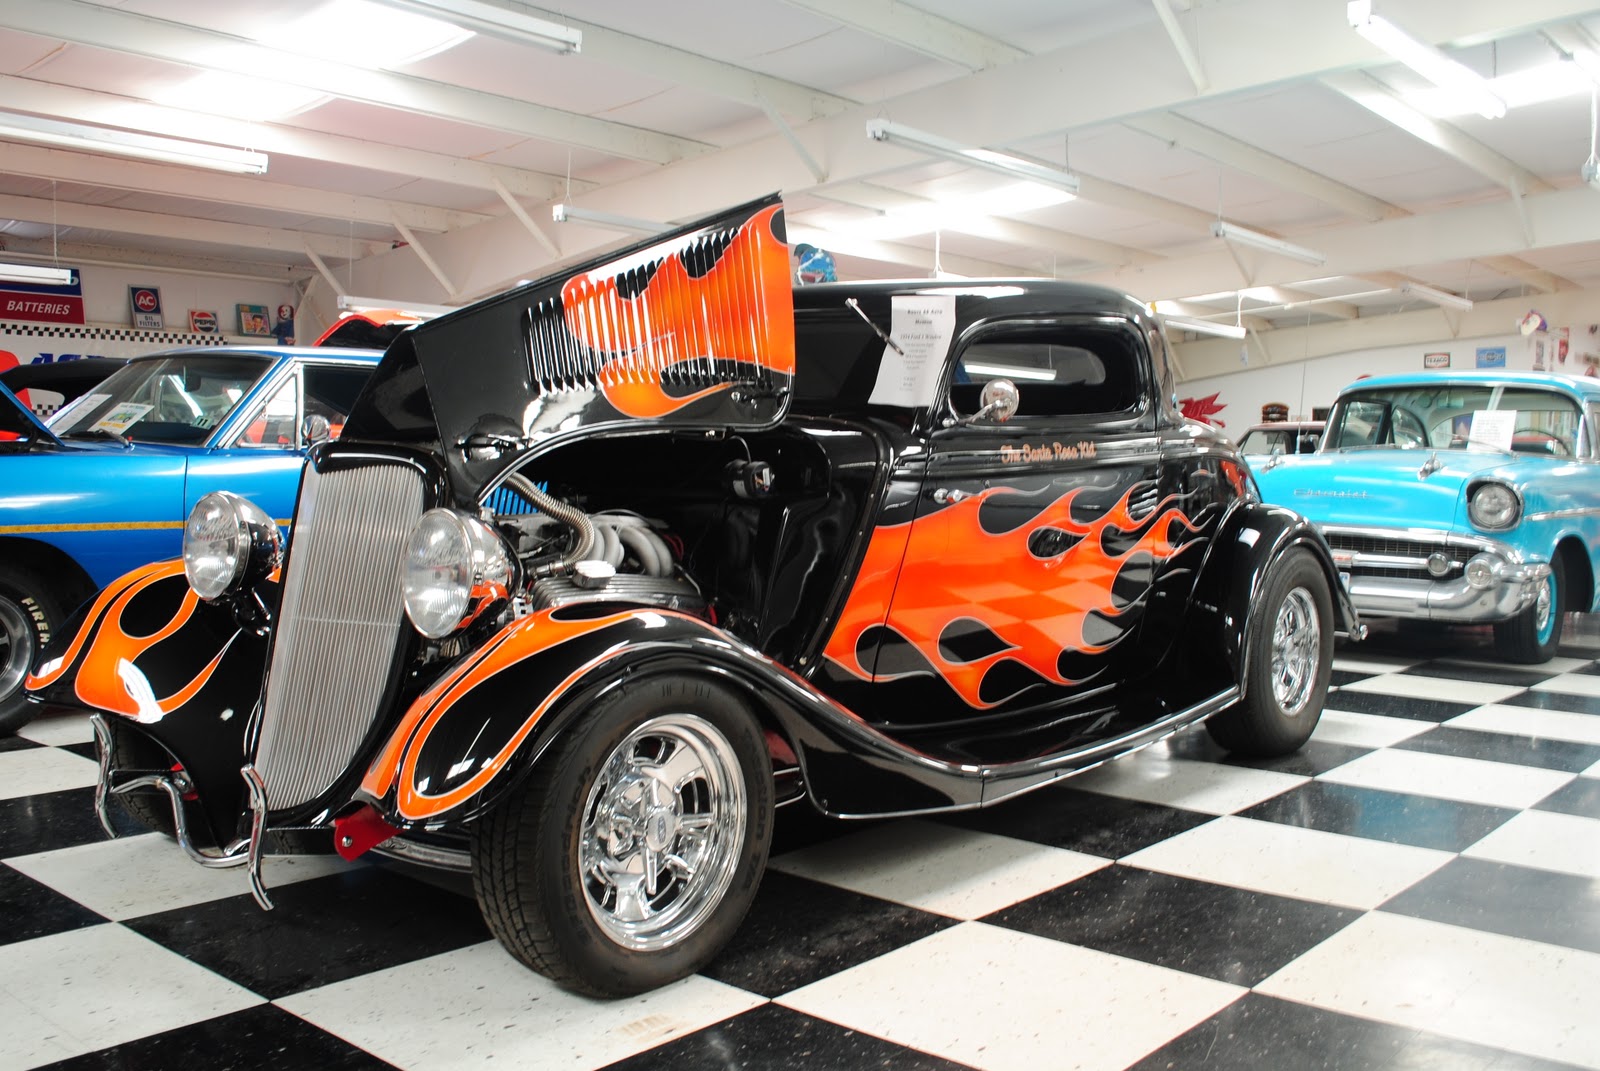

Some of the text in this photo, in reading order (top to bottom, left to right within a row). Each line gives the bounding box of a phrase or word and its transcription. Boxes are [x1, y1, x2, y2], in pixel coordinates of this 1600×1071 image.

[139, 296, 154, 306] AC
[6, 300, 70, 315] BATTERIES
[139, 320, 160, 328] FILTERS
[194, 318, 217, 327] PEPSI
[1426, 356, 1448, 364] TEXACO
[1023, 444, 1053, 463] Santa
[20, 596, 51, 650] FIREH
